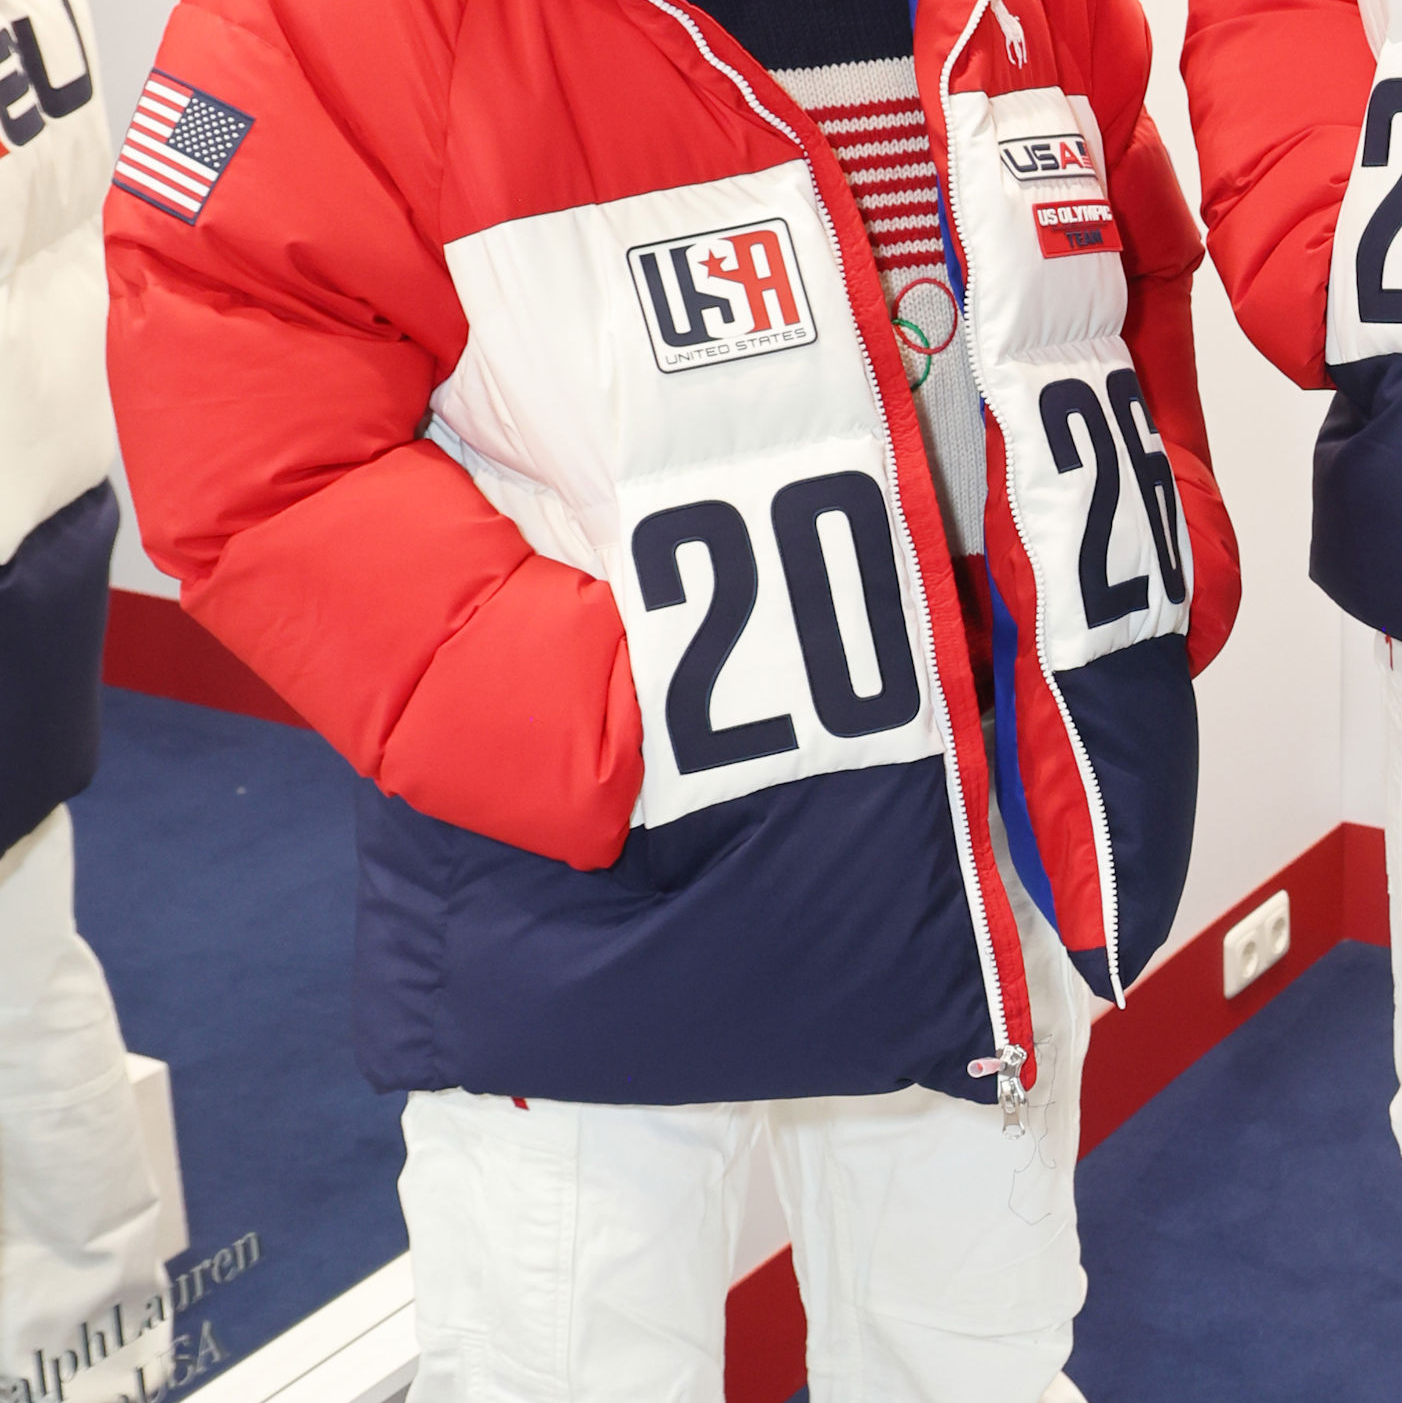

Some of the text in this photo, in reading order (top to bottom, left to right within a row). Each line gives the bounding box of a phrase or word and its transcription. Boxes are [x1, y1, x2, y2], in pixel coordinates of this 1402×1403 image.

[1003, 141, 1084, 173] USA
[1037, 204, 1113, 226] US OLYMPIC
[1065, 229, 1104, 249] TEAM
[639, 229, 801, 348] USA
[665, 327, 807, 365] UNITED STATES
[631, 367, 1187, 775] 20 26
